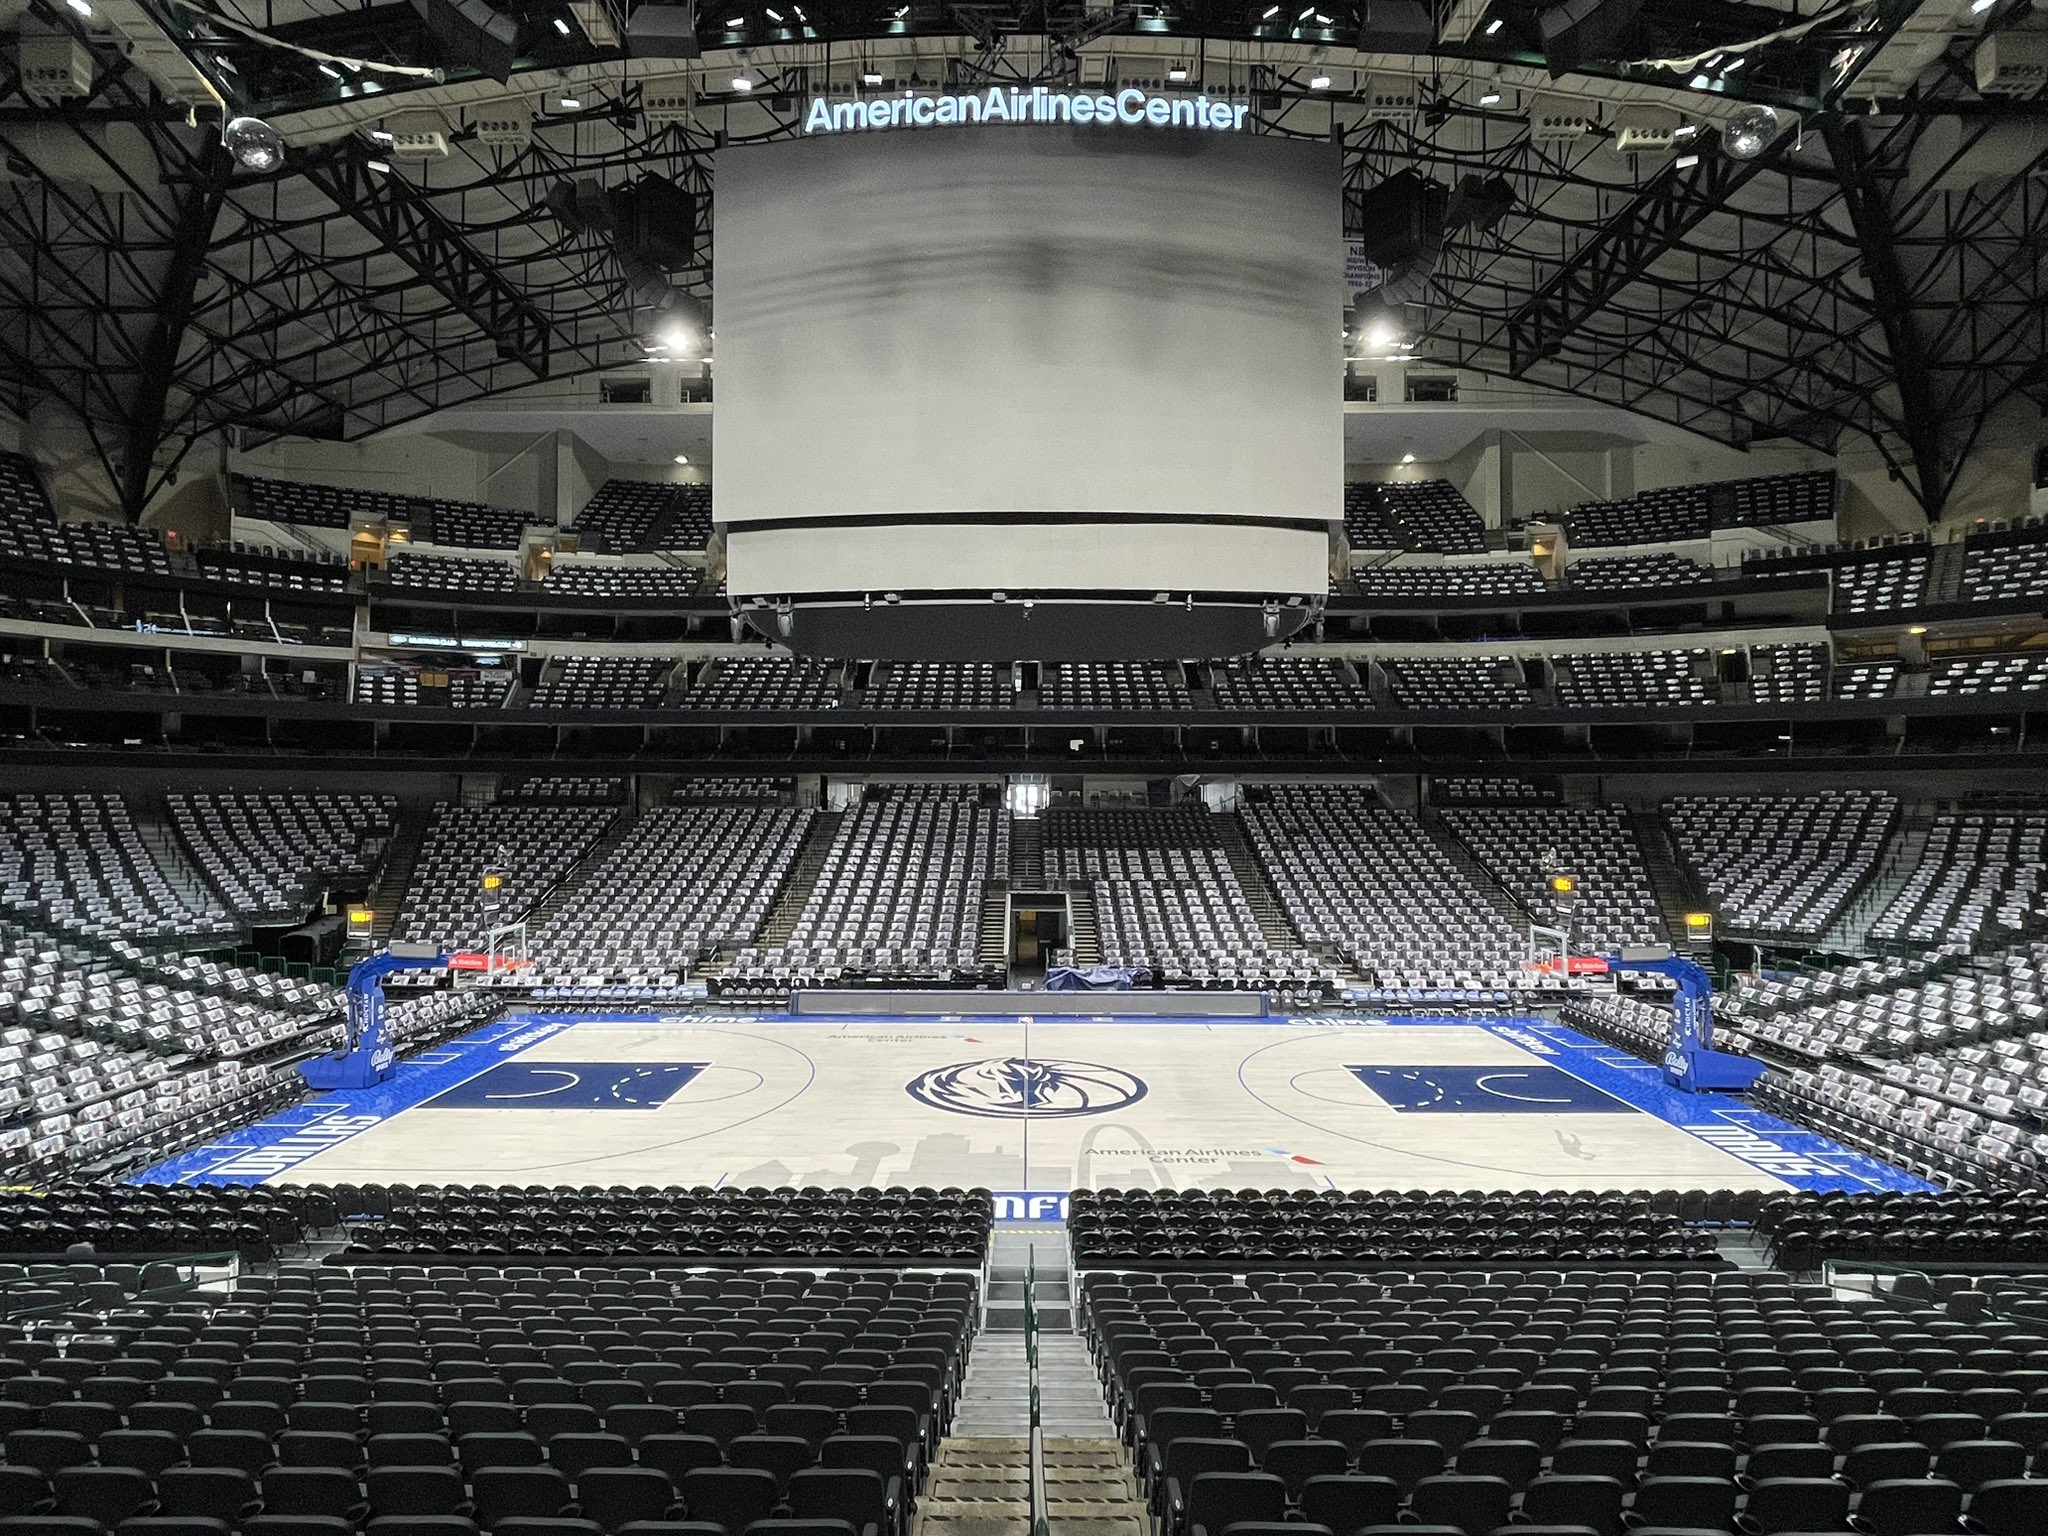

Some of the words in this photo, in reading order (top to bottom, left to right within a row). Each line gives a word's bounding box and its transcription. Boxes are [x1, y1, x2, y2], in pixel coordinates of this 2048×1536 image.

[1350, 246, 1365, 256] NB
[660, 1015, 757, 1023] chime
[371, 1047, 394, 1067] Bally
[1665, 1051, 1689, 1074] Bally
[207, 1115, 382, 1176] DALLAS
[1084, 1148, 1182, 1156] American
[1185, 1148, 1262, 1156] Airlines
[1681, 1125, 1841, 1176] MAVS
[1149, 1156, 1219, 1164] Center
